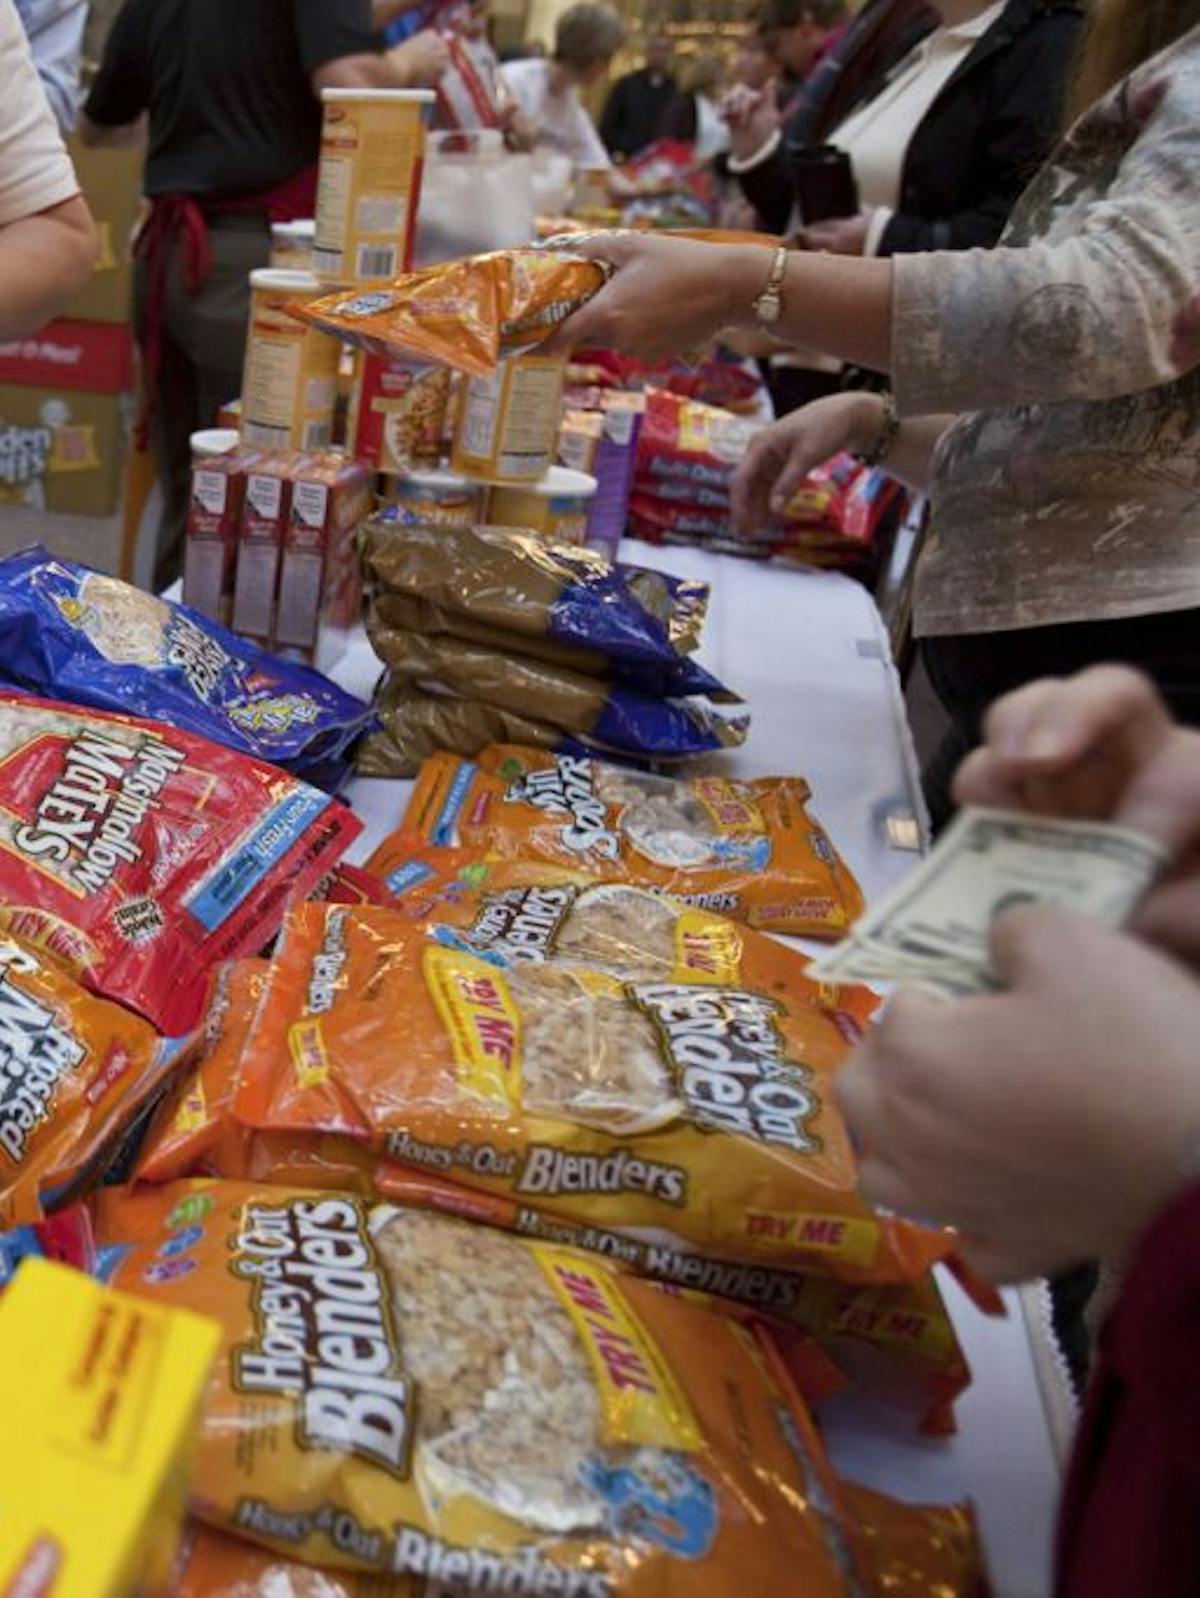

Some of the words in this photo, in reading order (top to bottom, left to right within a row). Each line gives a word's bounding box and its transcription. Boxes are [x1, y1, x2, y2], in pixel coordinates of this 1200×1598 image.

[72, 738, 187, 895] Marshmallow
[750, 1081, 813, 1149] Oat
[518, 1147, 685, 1201] Blenders
[237, 1258, 283, 1275] &
[801, 1219, 847, 1246] ME
[553, 1264, 616, 1321] ME
[240, 1277, 313, 1389] Honey
[284, 1198, 407, 1466] Blenders
[585, 1317, 658, 1394] TRY
